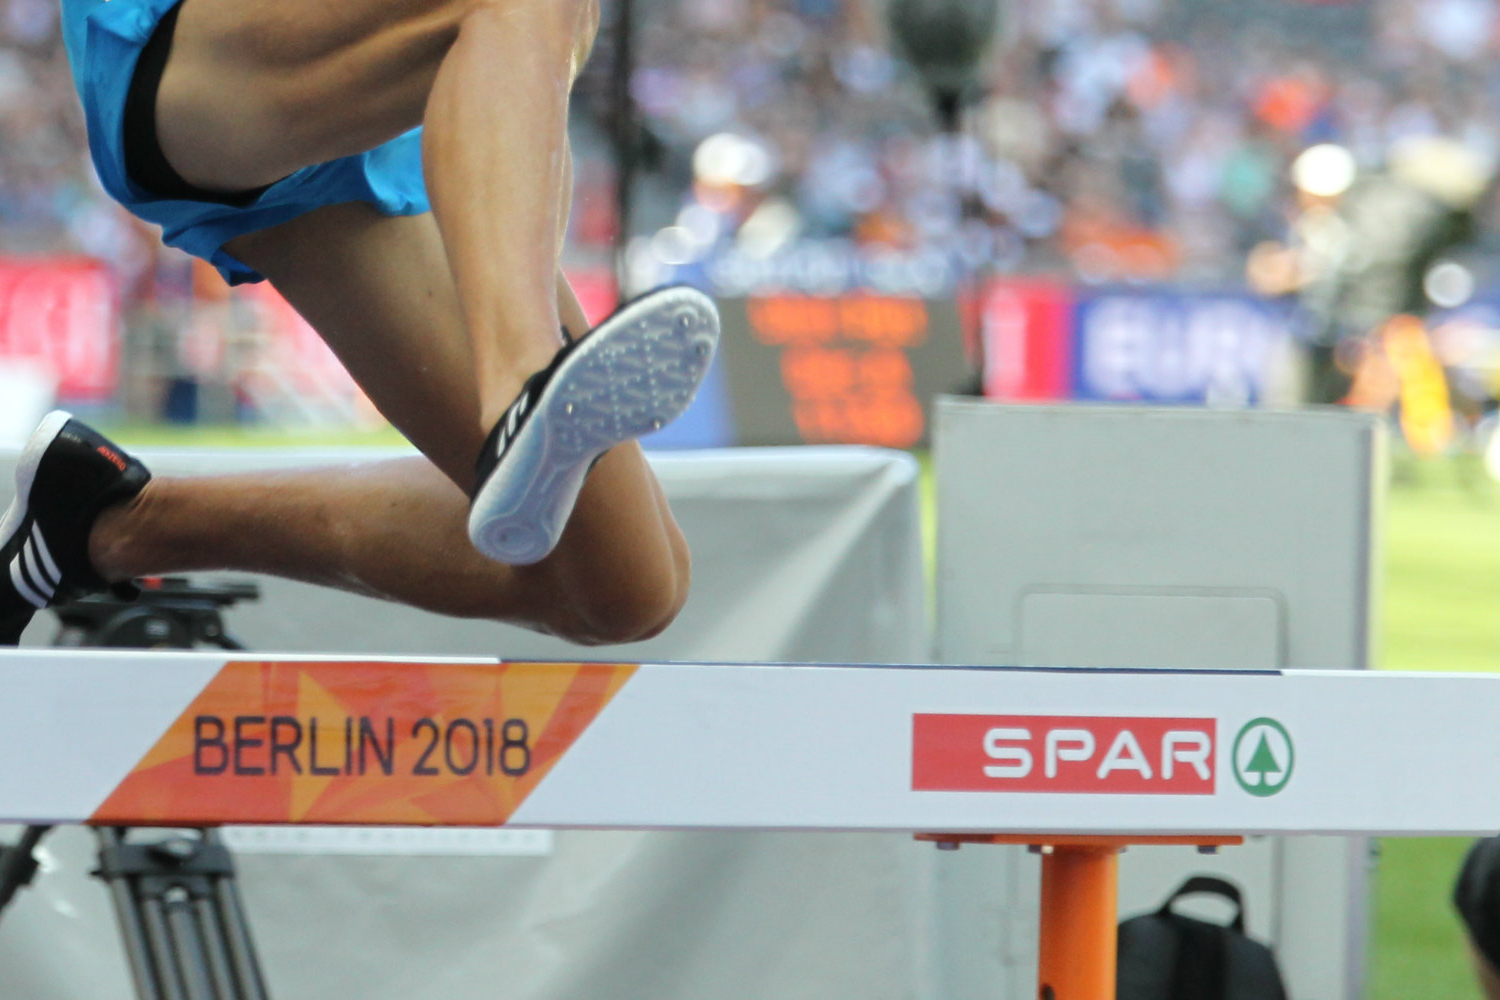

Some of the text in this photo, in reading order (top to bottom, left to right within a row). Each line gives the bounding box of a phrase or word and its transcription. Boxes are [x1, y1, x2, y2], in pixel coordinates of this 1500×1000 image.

[193, 715, 532, 778] BERLIN 2018
[983, 728, 1212, 780] SPAR
